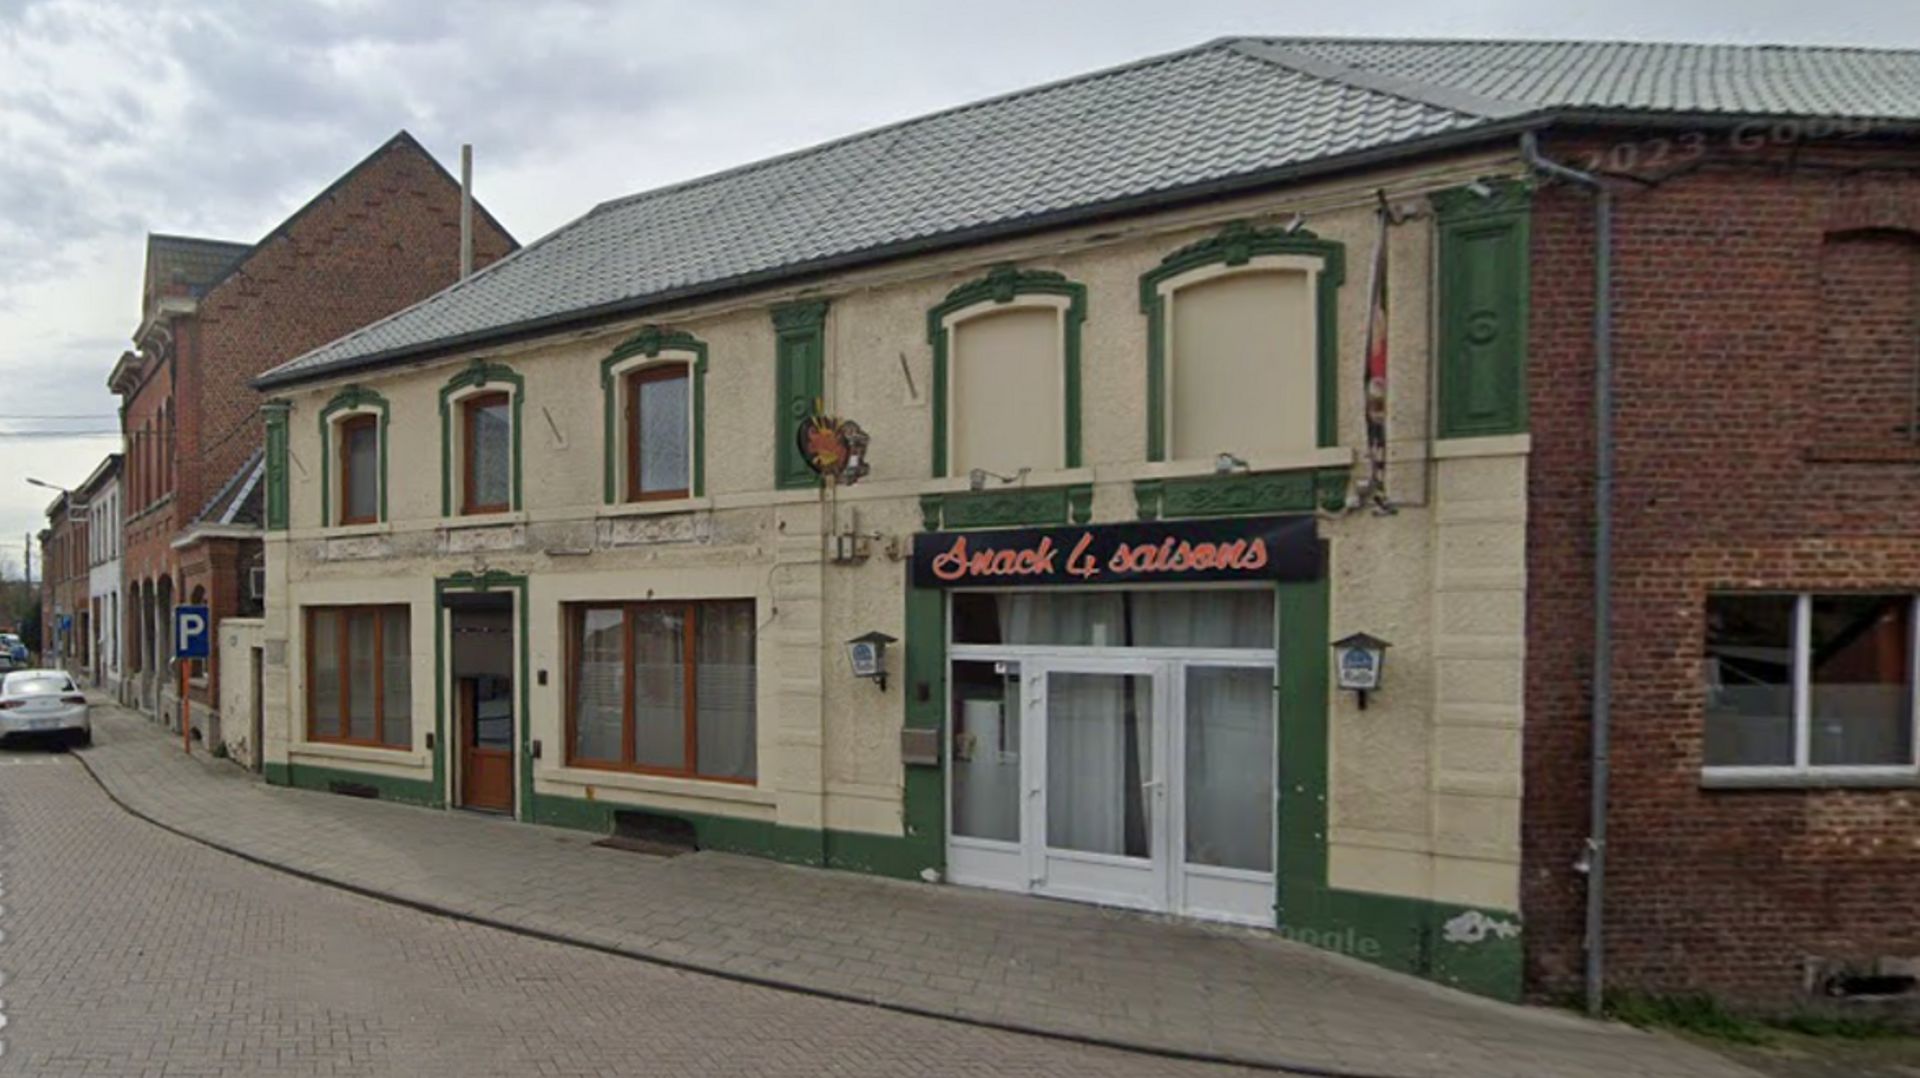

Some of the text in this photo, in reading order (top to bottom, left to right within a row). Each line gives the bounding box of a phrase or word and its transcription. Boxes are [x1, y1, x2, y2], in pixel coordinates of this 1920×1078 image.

[932, 531, 1268, 580] Snack 4 saisons
[179, 613, 205, 651] P
